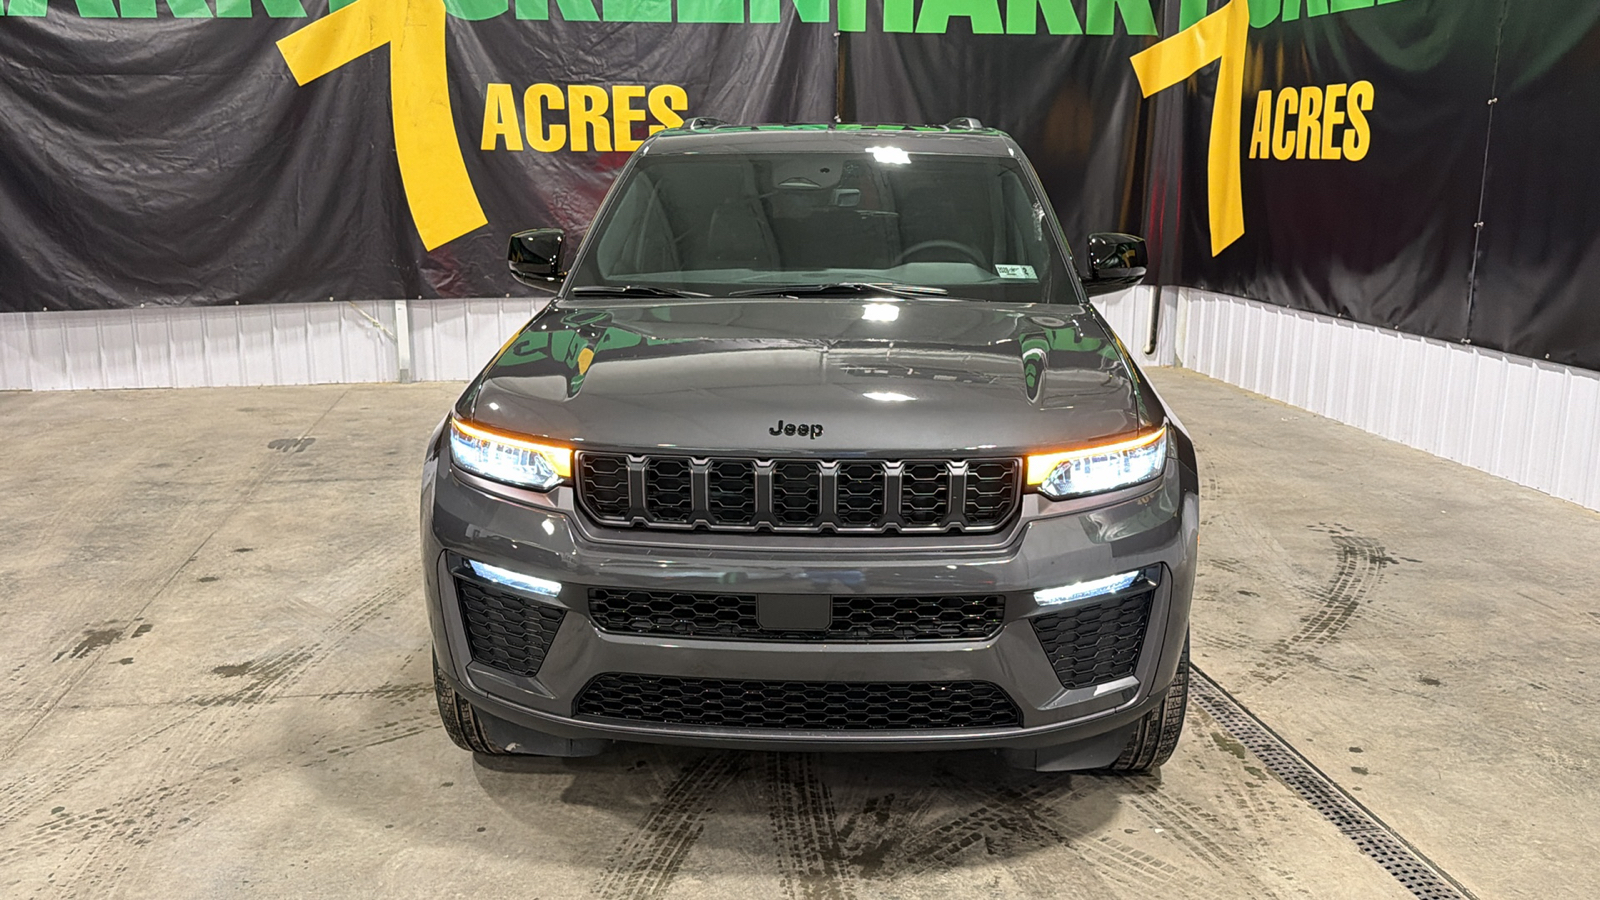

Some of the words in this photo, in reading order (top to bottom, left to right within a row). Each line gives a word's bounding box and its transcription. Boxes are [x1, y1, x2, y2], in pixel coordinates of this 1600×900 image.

[481, 83, 689, 152] ACRES
[1248, 80, 1375, 161] ACRES
[769, 420, 824, 440] Jeep
